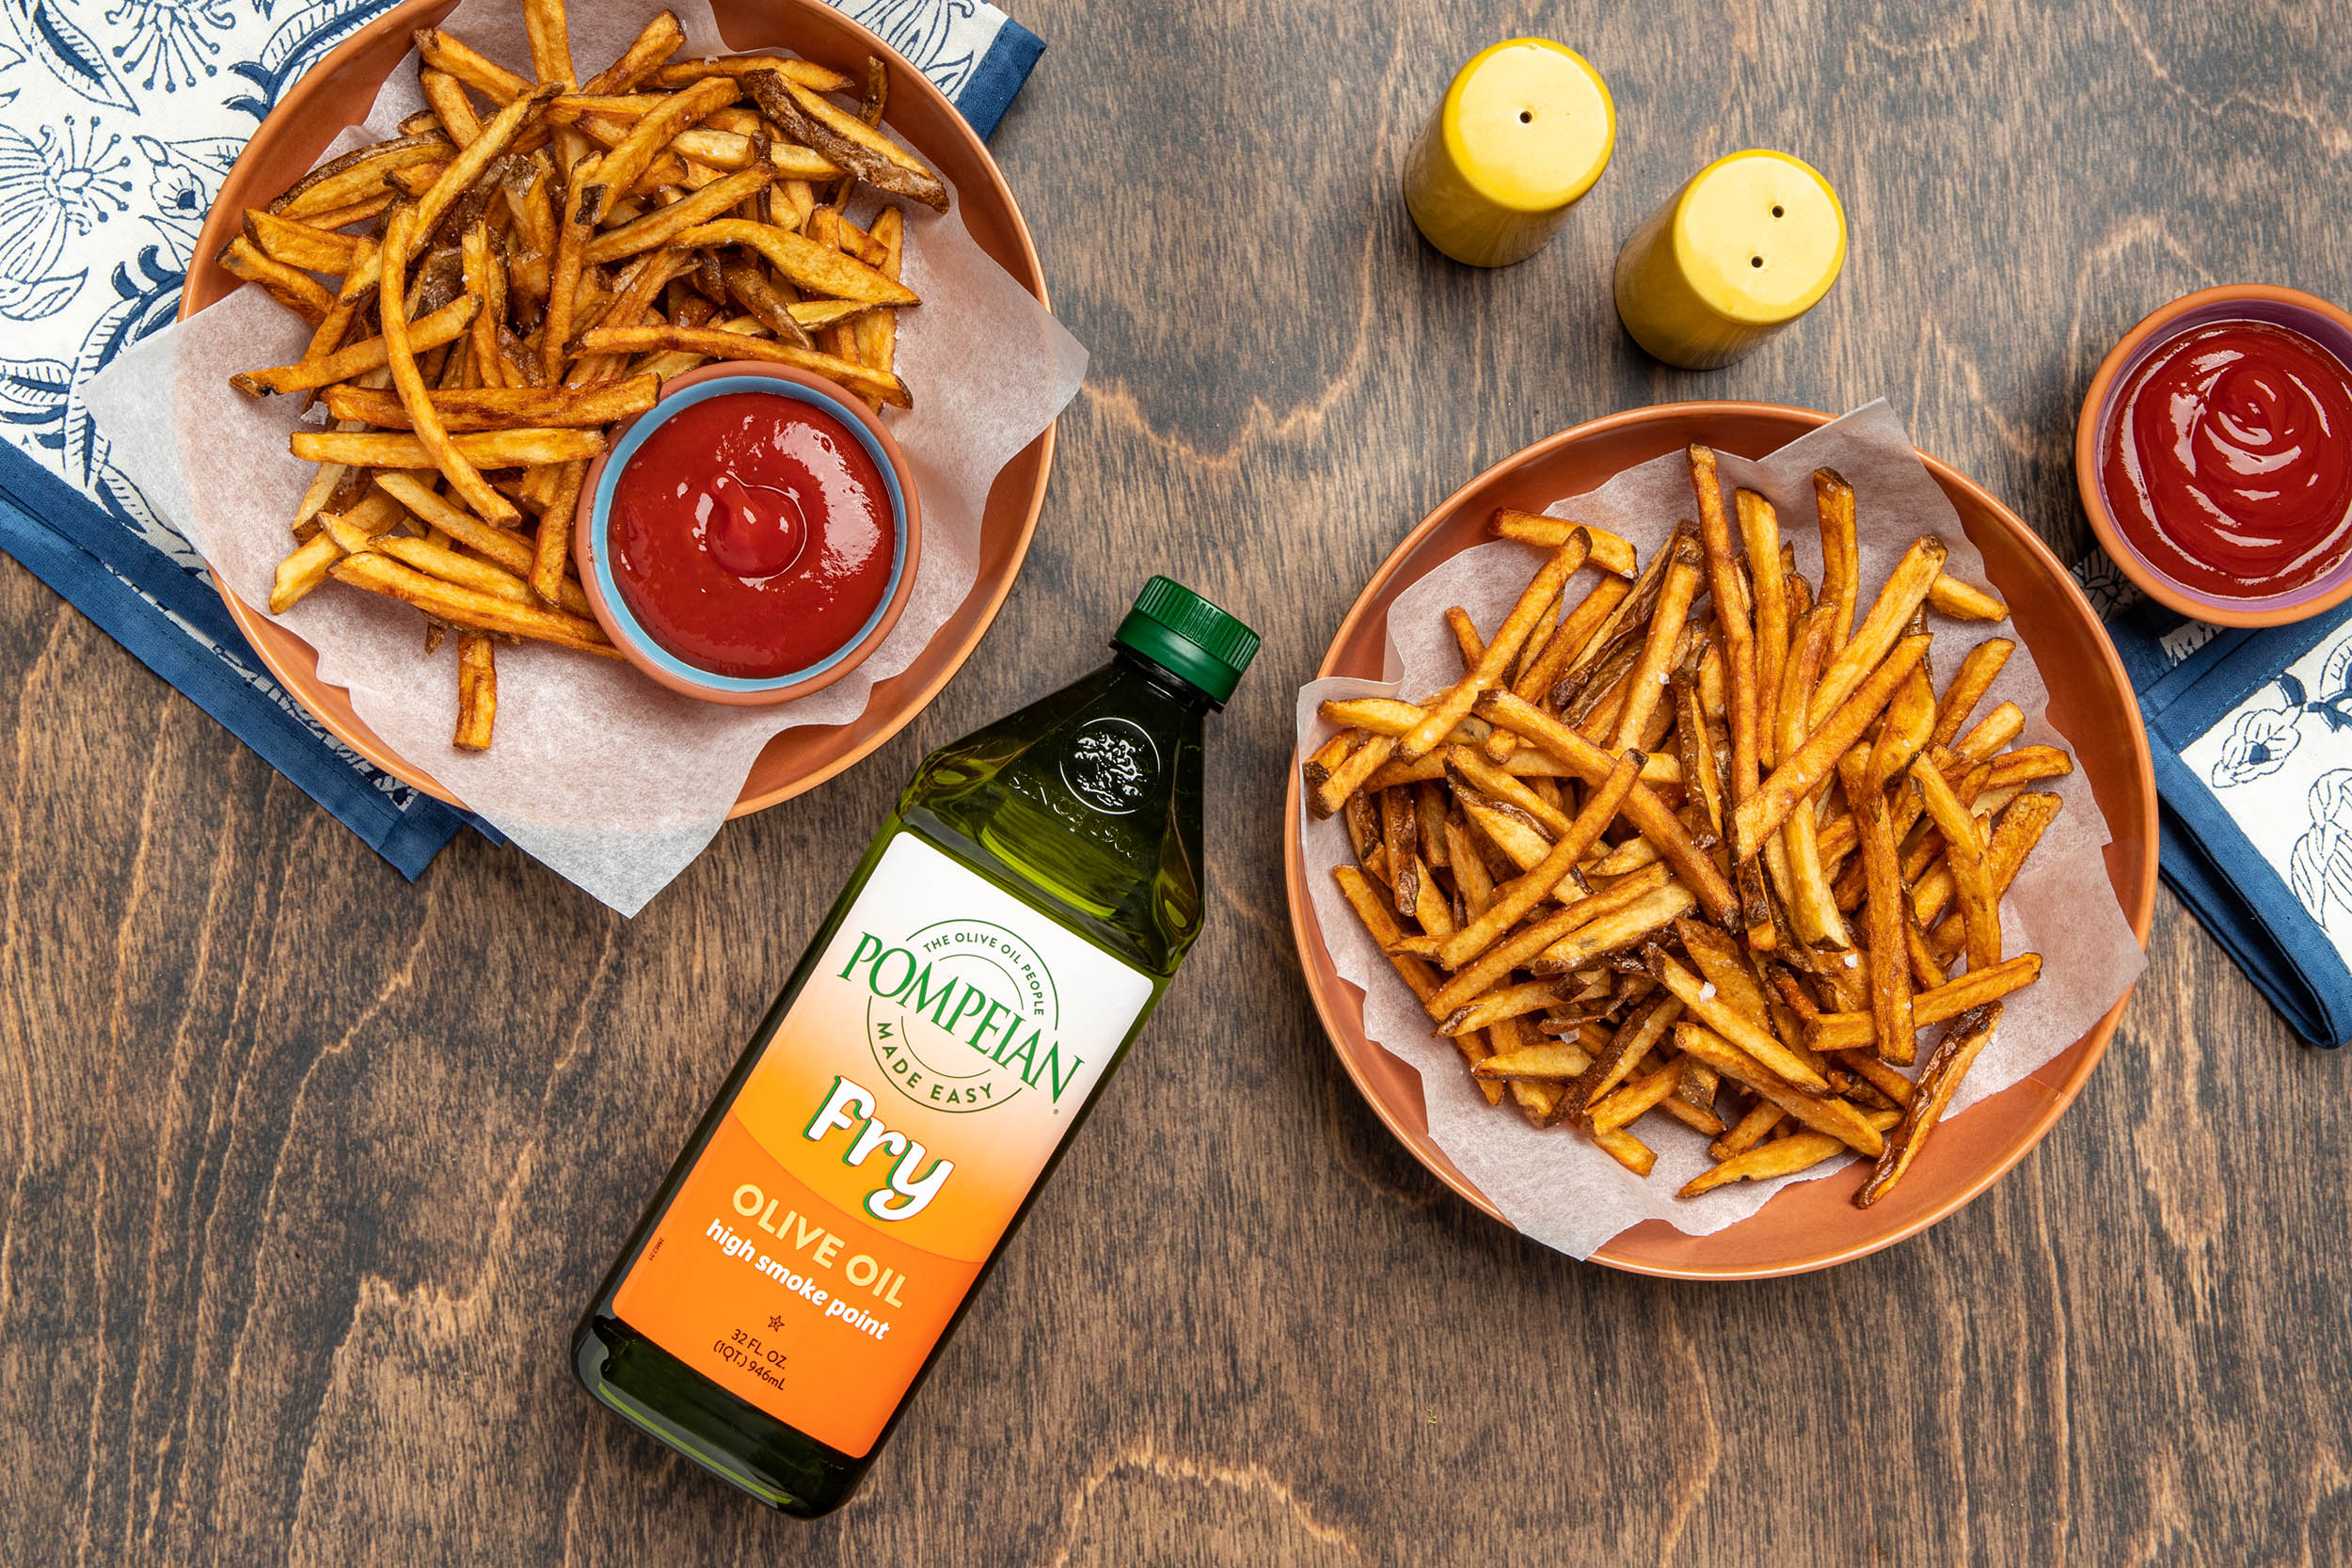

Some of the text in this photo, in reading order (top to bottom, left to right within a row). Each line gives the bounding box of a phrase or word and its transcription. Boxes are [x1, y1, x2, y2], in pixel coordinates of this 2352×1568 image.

[836, 931, 1086, 1104] POMPEIAN
[923, 932, 1045, 1017] THE OLIVE OIL PEOPLE
[877, 1022, 995, 1104] MADE EASY
[803, 1075, 956, 1222] Fry
[706, 1218, 891, 1340] high smoke point
[733, 1184, 907, 1308] OLIVE OIL
[713, 1339, 785, 1391] (1QT.) 946mL
[731, 1328, 787, 1370] 32 FL. OZ.
